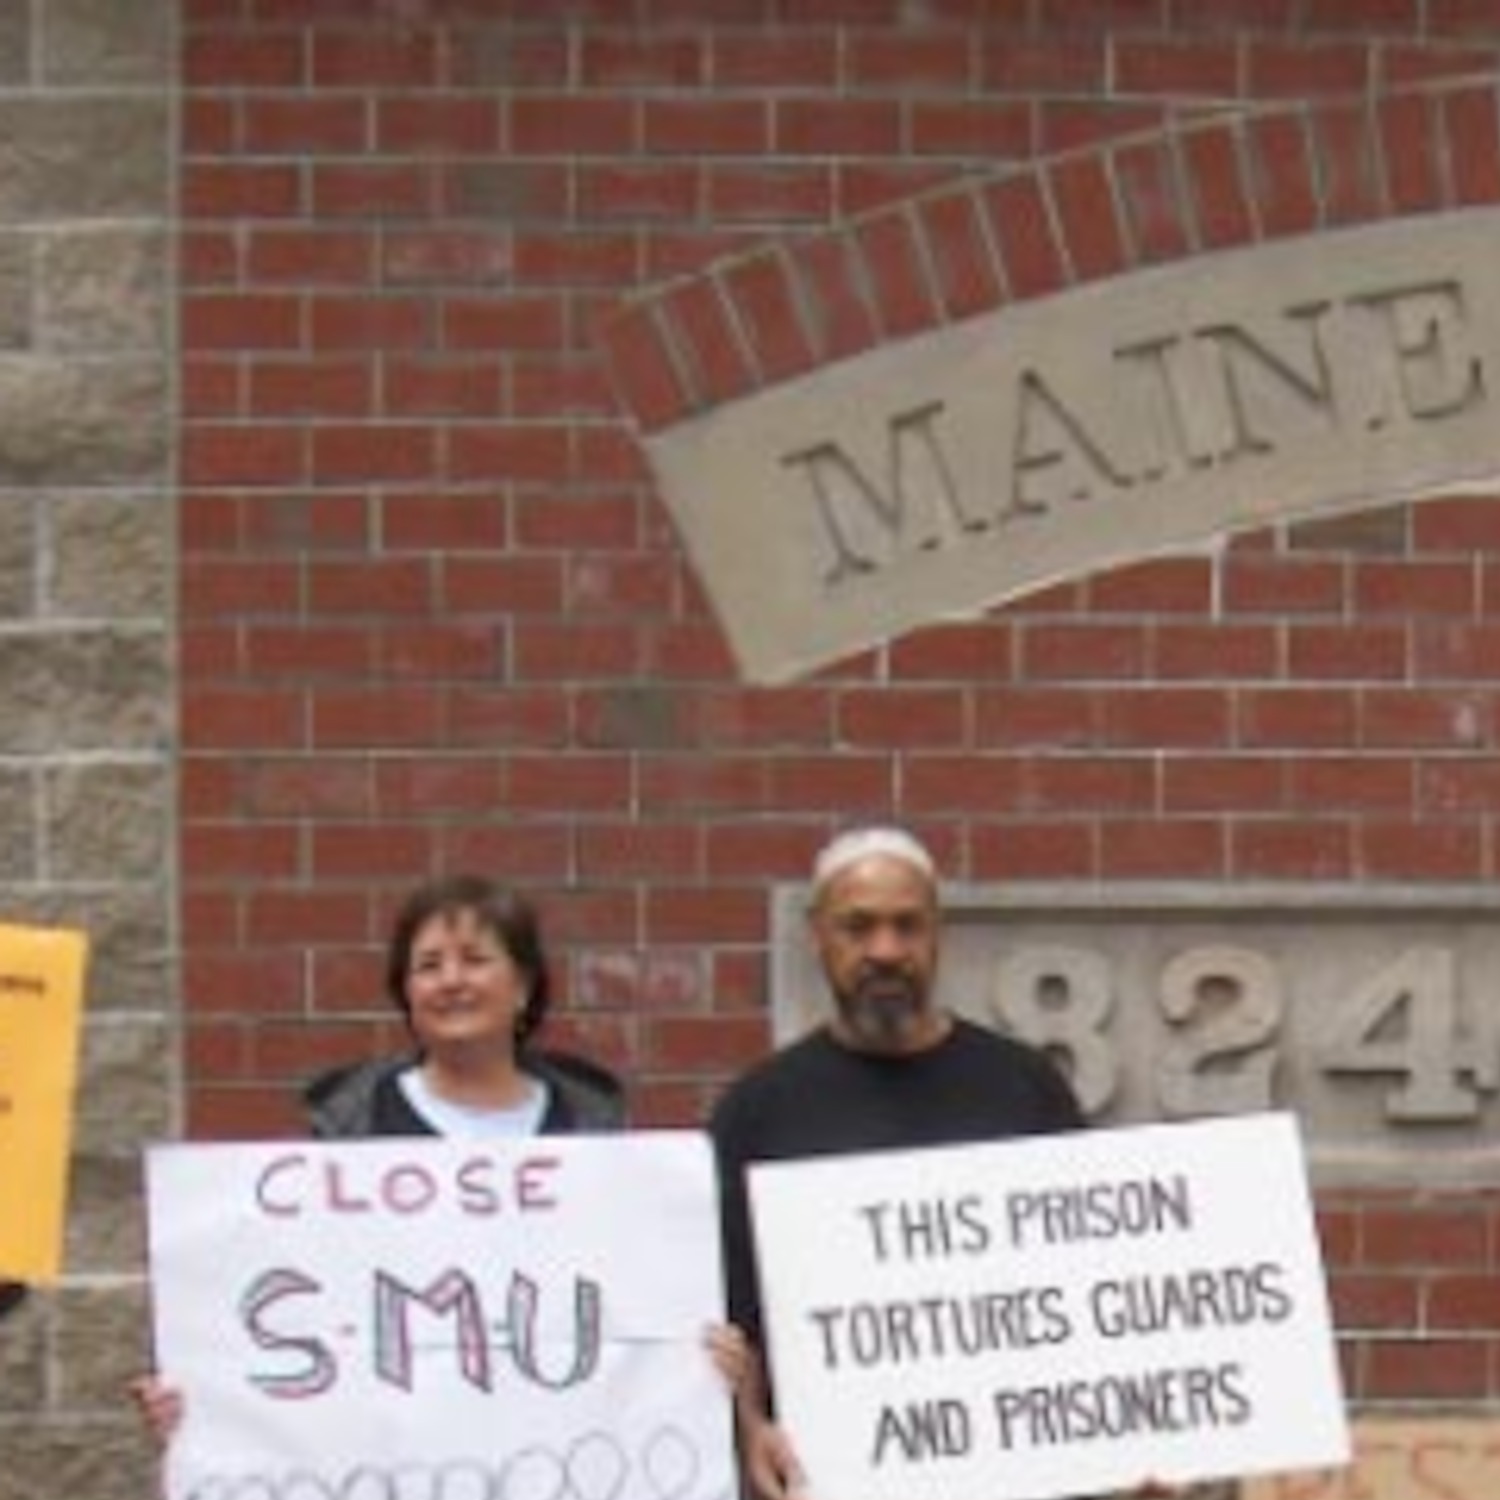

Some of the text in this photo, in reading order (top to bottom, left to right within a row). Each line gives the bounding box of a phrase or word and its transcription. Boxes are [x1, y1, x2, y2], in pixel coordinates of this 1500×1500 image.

[781, 278, 1486, 584] MAINE
[255, 1153, 562, 1215] CLOSE
[861, 1174, 1192, 1263] THIS PRISON
[809, 1263, 1293, 1371] TORTURES GUARDS
[873, 1364, 1252, 1467] AND PRISONERS
